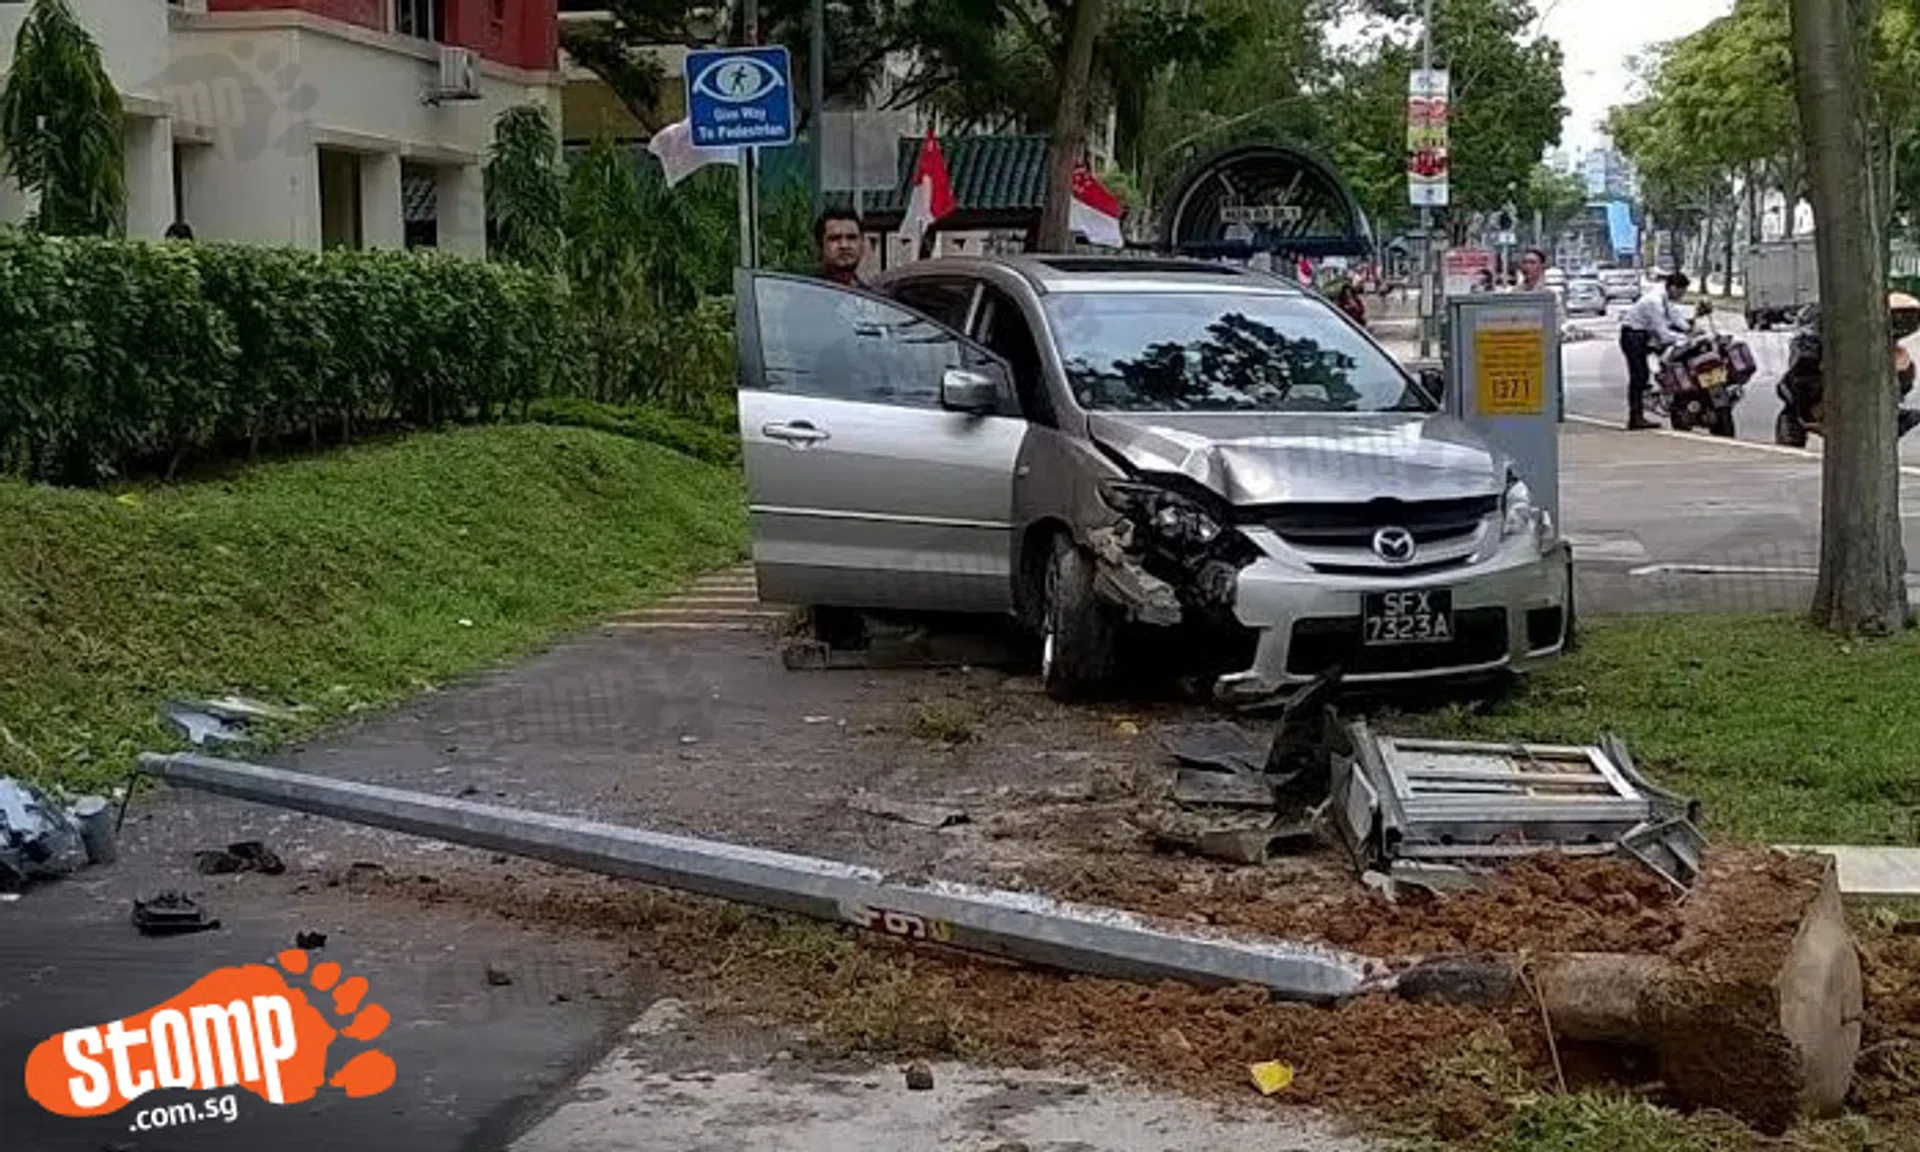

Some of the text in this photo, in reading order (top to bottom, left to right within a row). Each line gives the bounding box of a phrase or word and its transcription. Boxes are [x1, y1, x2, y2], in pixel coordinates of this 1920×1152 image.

[740, 106, 767, 121] Way
[698, 125, 715, 139] To
[1384, 590, 1431, 616] SFX
[1367, 611, 1449, 640] 7323A
